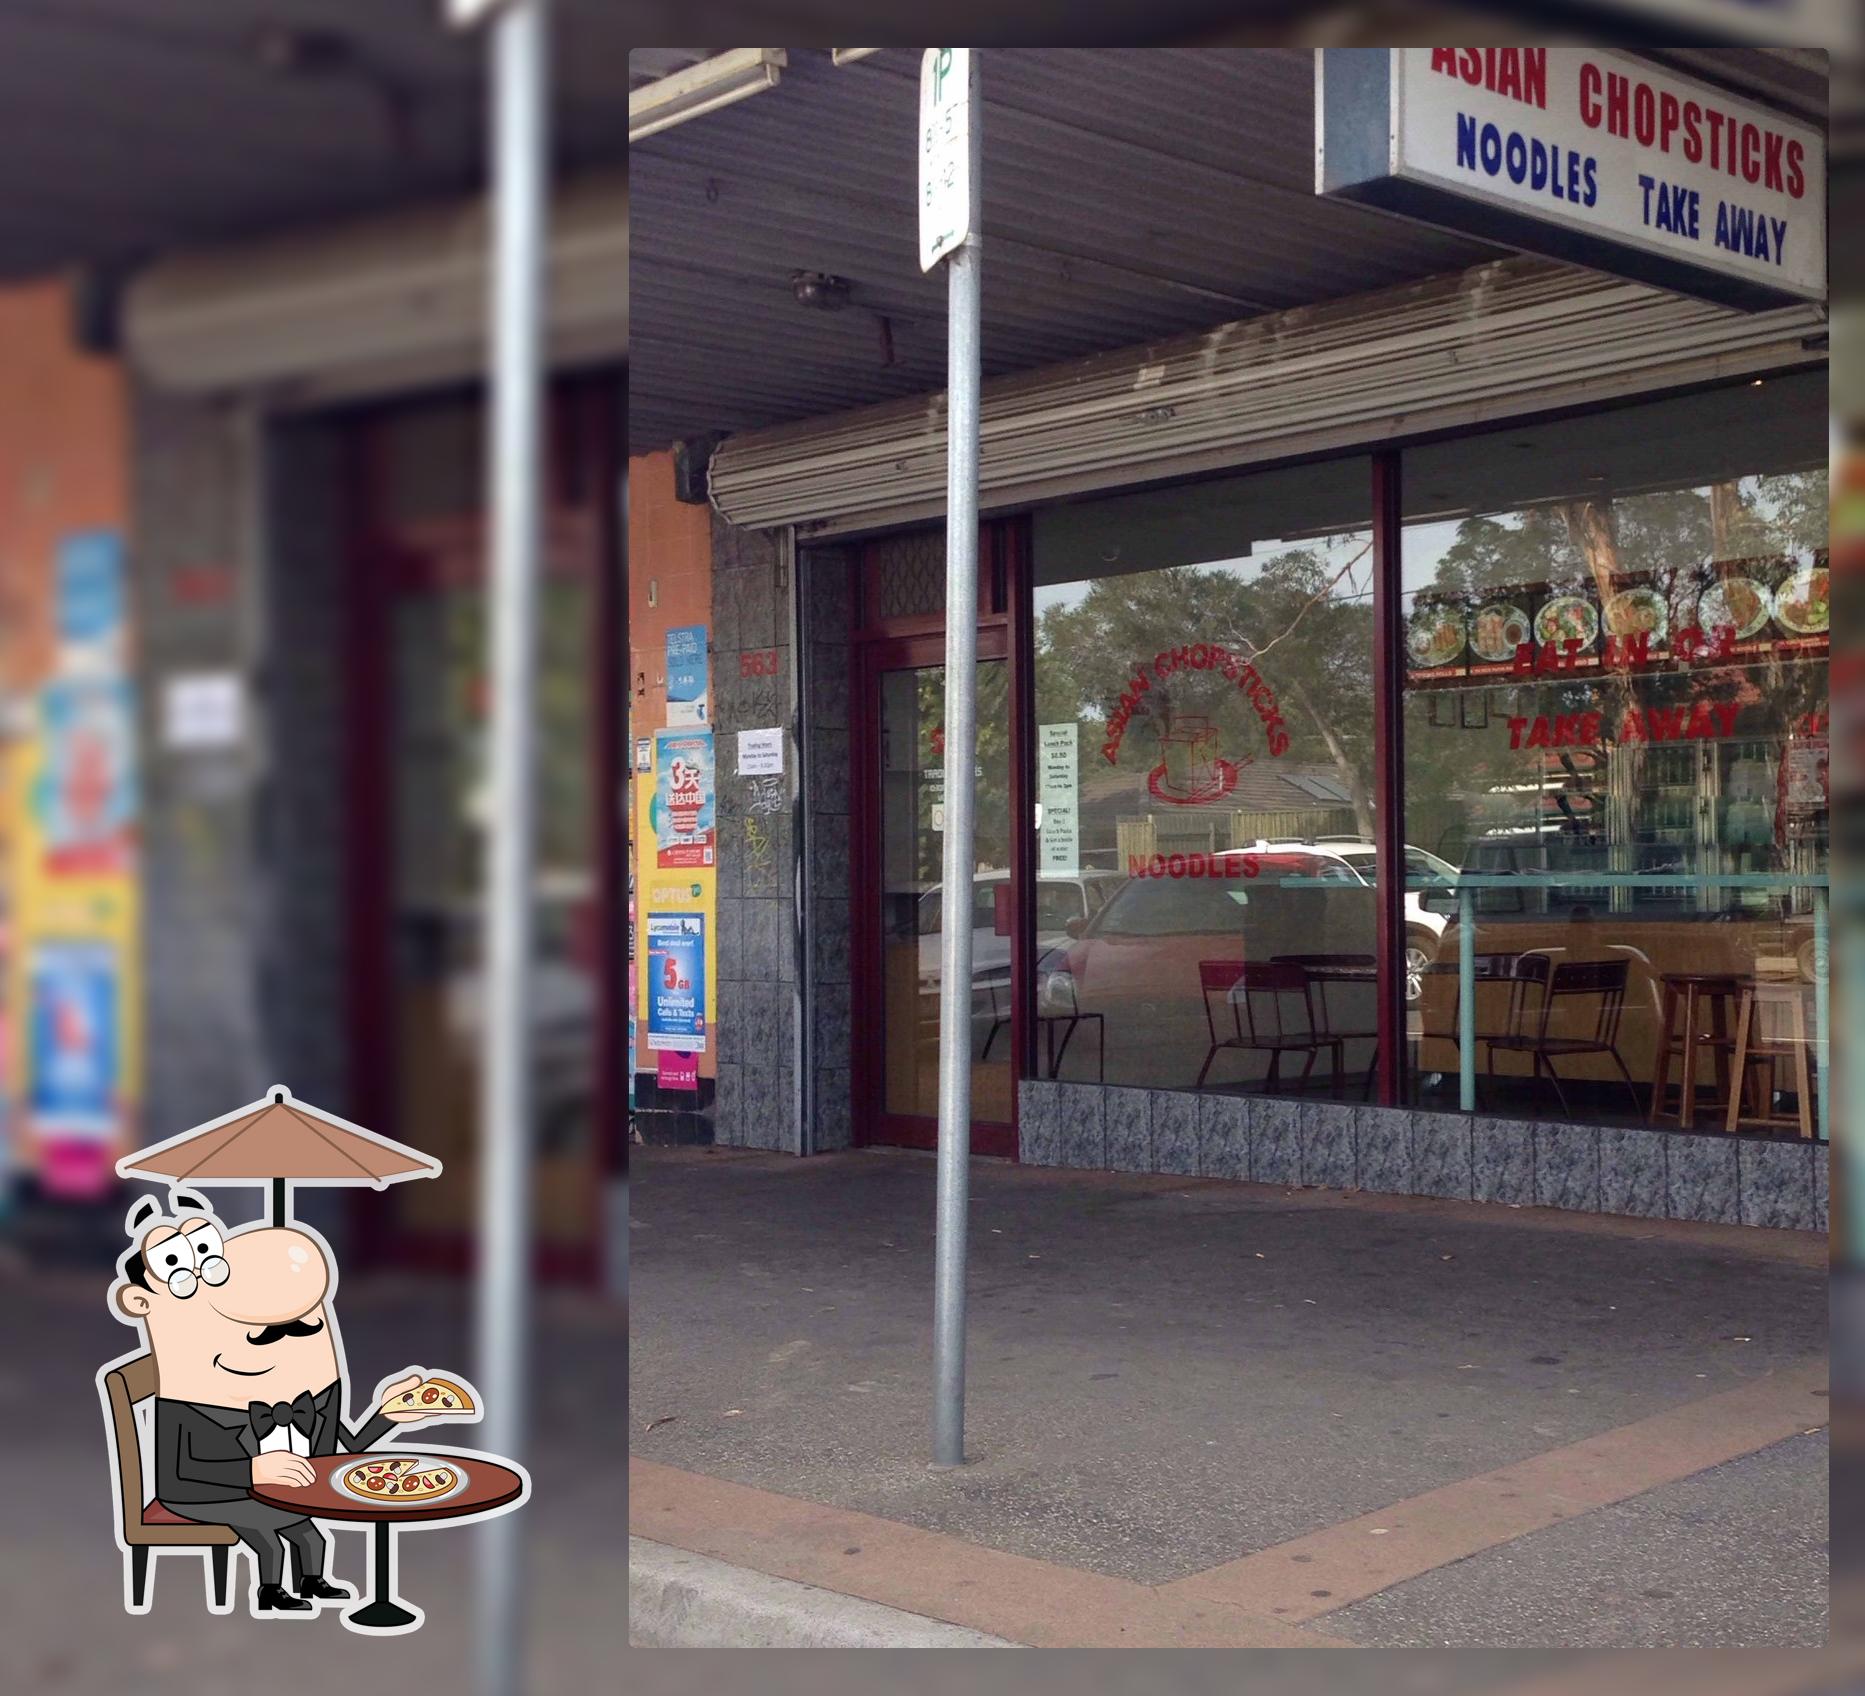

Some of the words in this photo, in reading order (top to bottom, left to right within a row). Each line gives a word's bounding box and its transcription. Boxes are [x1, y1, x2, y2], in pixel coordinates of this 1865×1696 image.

[1431, 48, 1546, 110] ASIAN
[1579, 63, 1804, 199] CHOPSTICKS
[1457, 112, 1597, 208] NOODLES
[1638, 175, 1699, 239] TAKE
[1715, 201, 1787, 266] AWAY
[1513, 638, 1583, 675] EAT
[1602, 631, 1650, 669] IN
[1102, 671, 1151, 765] ASIAN
[1155, 643, 1290, 756] CHOPSTICKS
[1507, 711, 1602, 750] TAKE
[1620, 702, 1742, 743] AWAY
[1128, 853, 1260, 879] NOODLES
[664, 958, 678, 990] 5
[678, 979, 690, 990] GB
[657, 996, 695, 1009] Unlimited
